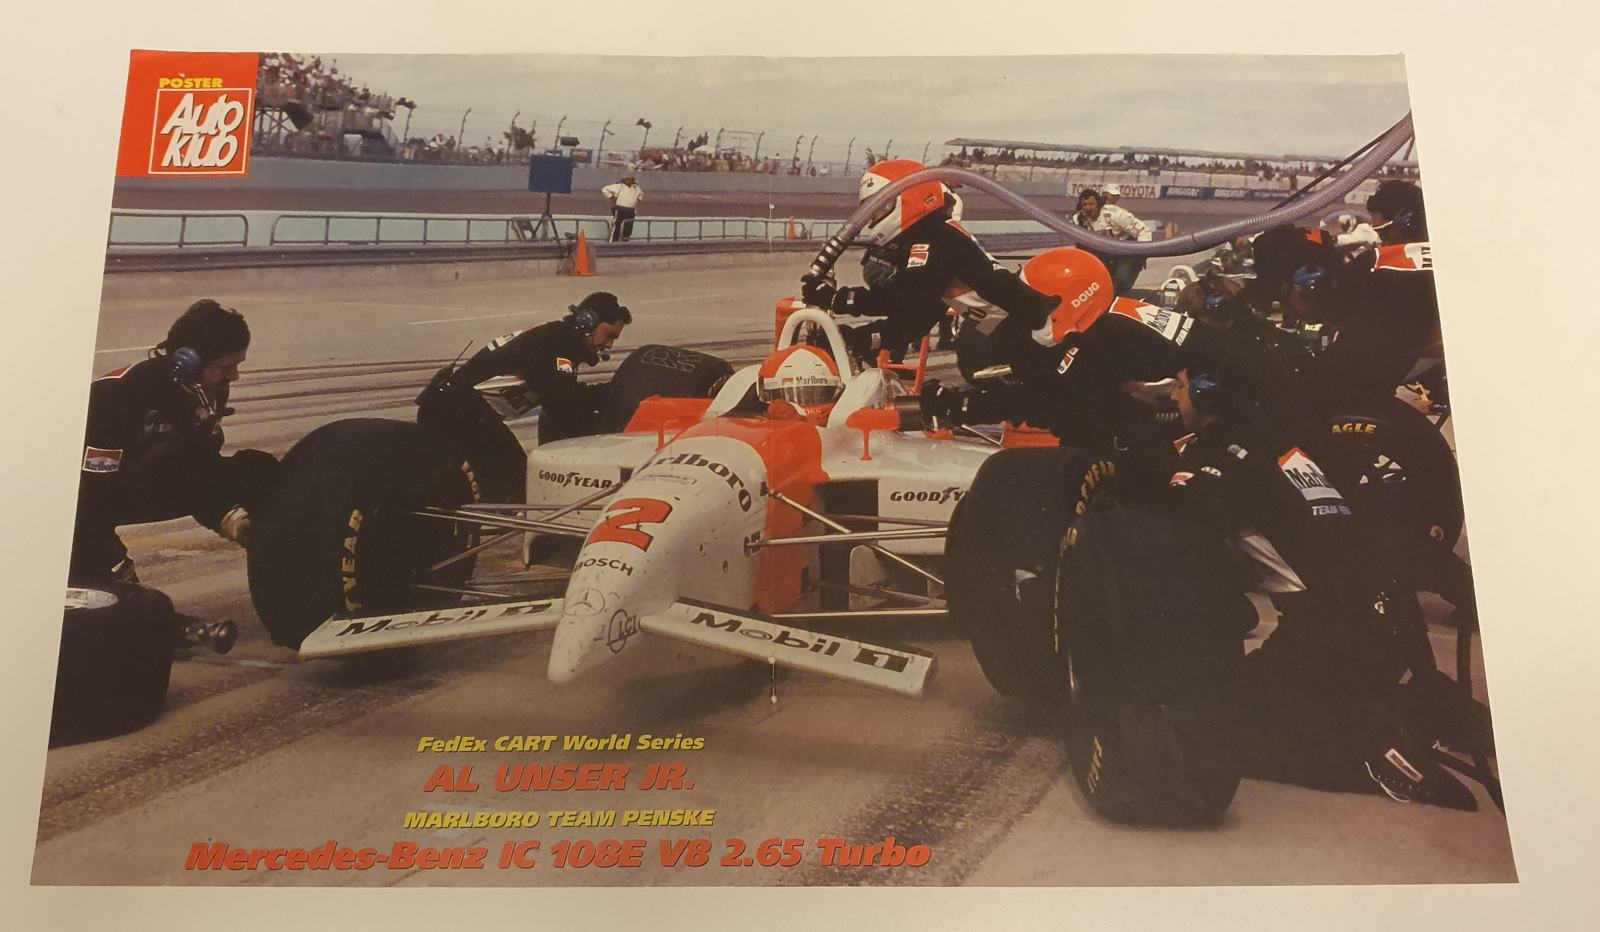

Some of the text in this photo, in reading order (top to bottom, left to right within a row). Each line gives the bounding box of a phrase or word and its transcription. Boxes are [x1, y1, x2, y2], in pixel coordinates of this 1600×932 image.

[159, 77, 223, 88] POSTER
[160, 93, 245, 136] Auto
[1071, 281, 1100, 308] DOUG
[1331, 422, 1377, 434] AGLE
[538, 470, 613, 489] GOODYEAR
[587, 498, 673, 552] 2
[336, 609, 488, 637] Mobil
[689, 611, 840, 656] Mobil
[418, 734, 705, 752] FedEx CART World Series
[423, 763, 695, 793] AL UNSER JR.
[404, 809, 716, 829] MARLBORO TEAM PENSKE
[185, 837, 932, 871] Mercedes-Benz IC 108E V8 2.65 Turbo
